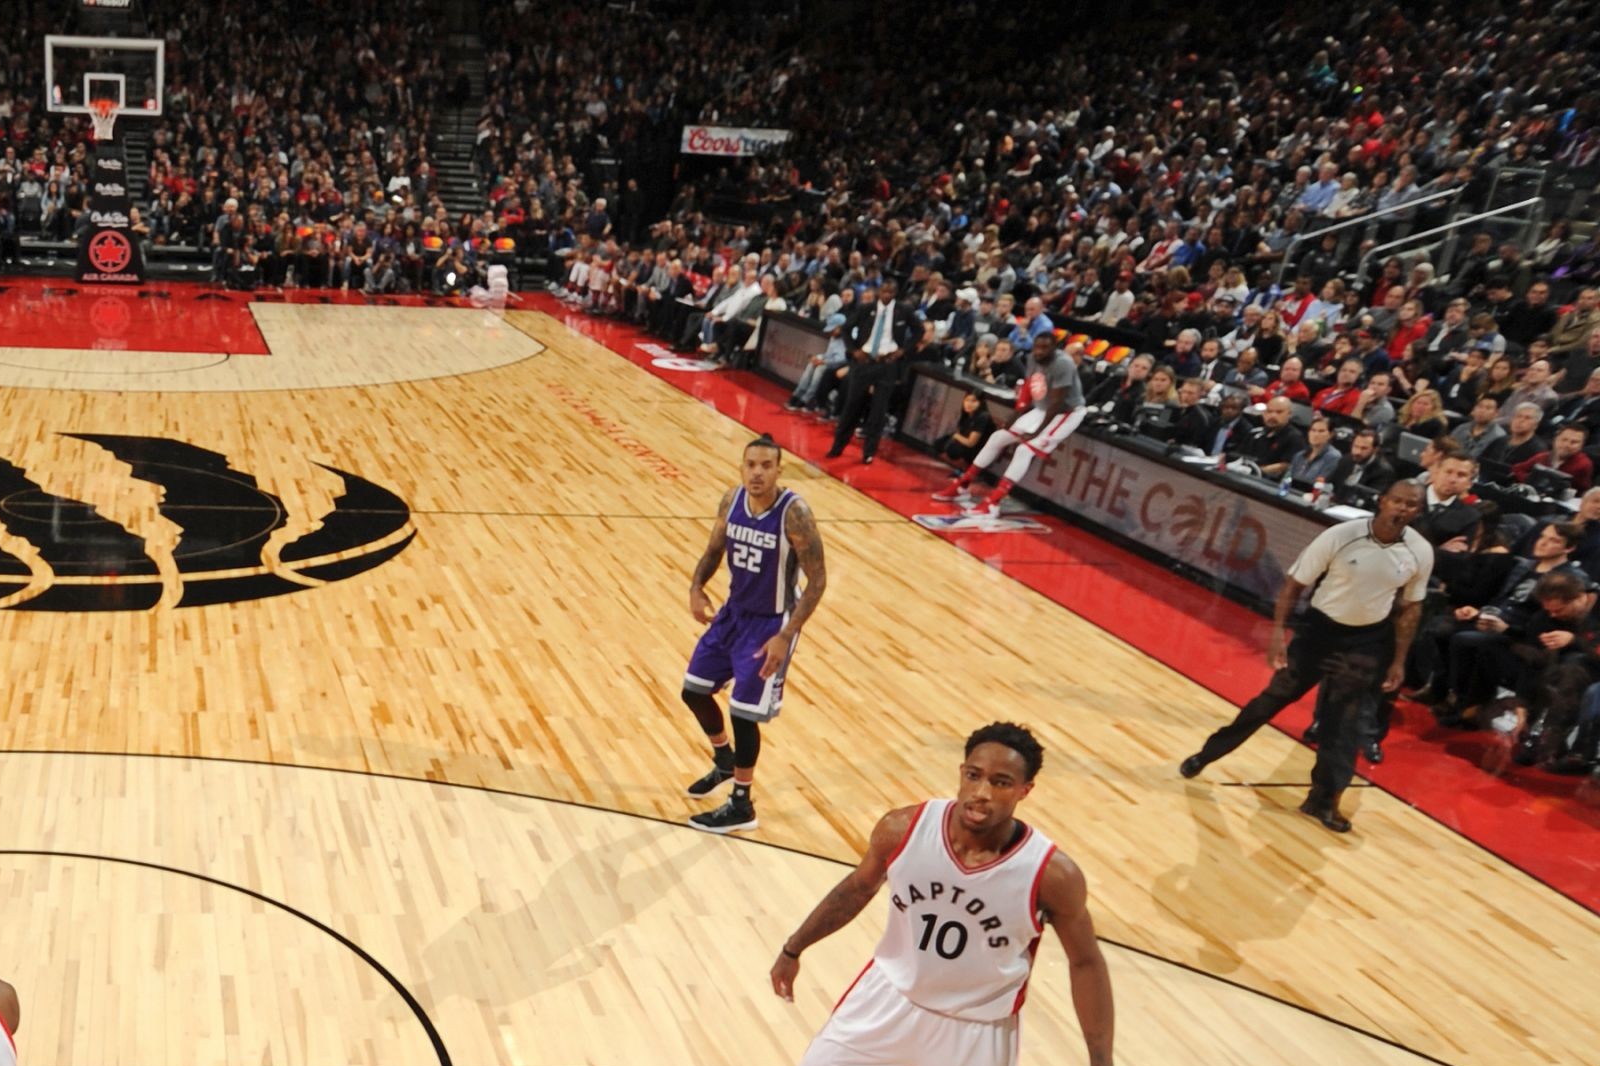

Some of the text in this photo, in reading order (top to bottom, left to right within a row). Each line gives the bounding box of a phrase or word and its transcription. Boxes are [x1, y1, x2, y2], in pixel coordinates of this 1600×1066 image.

[688, 128, 741, 153] Coors
[1065, 449, 1140, 519] THE
[726, 522, 777, 550] KINGS
[732, 542, 764, 574] 22
[891, 881, 1010, 949] RAPTORS
[917, 912, 969, 961] 10
